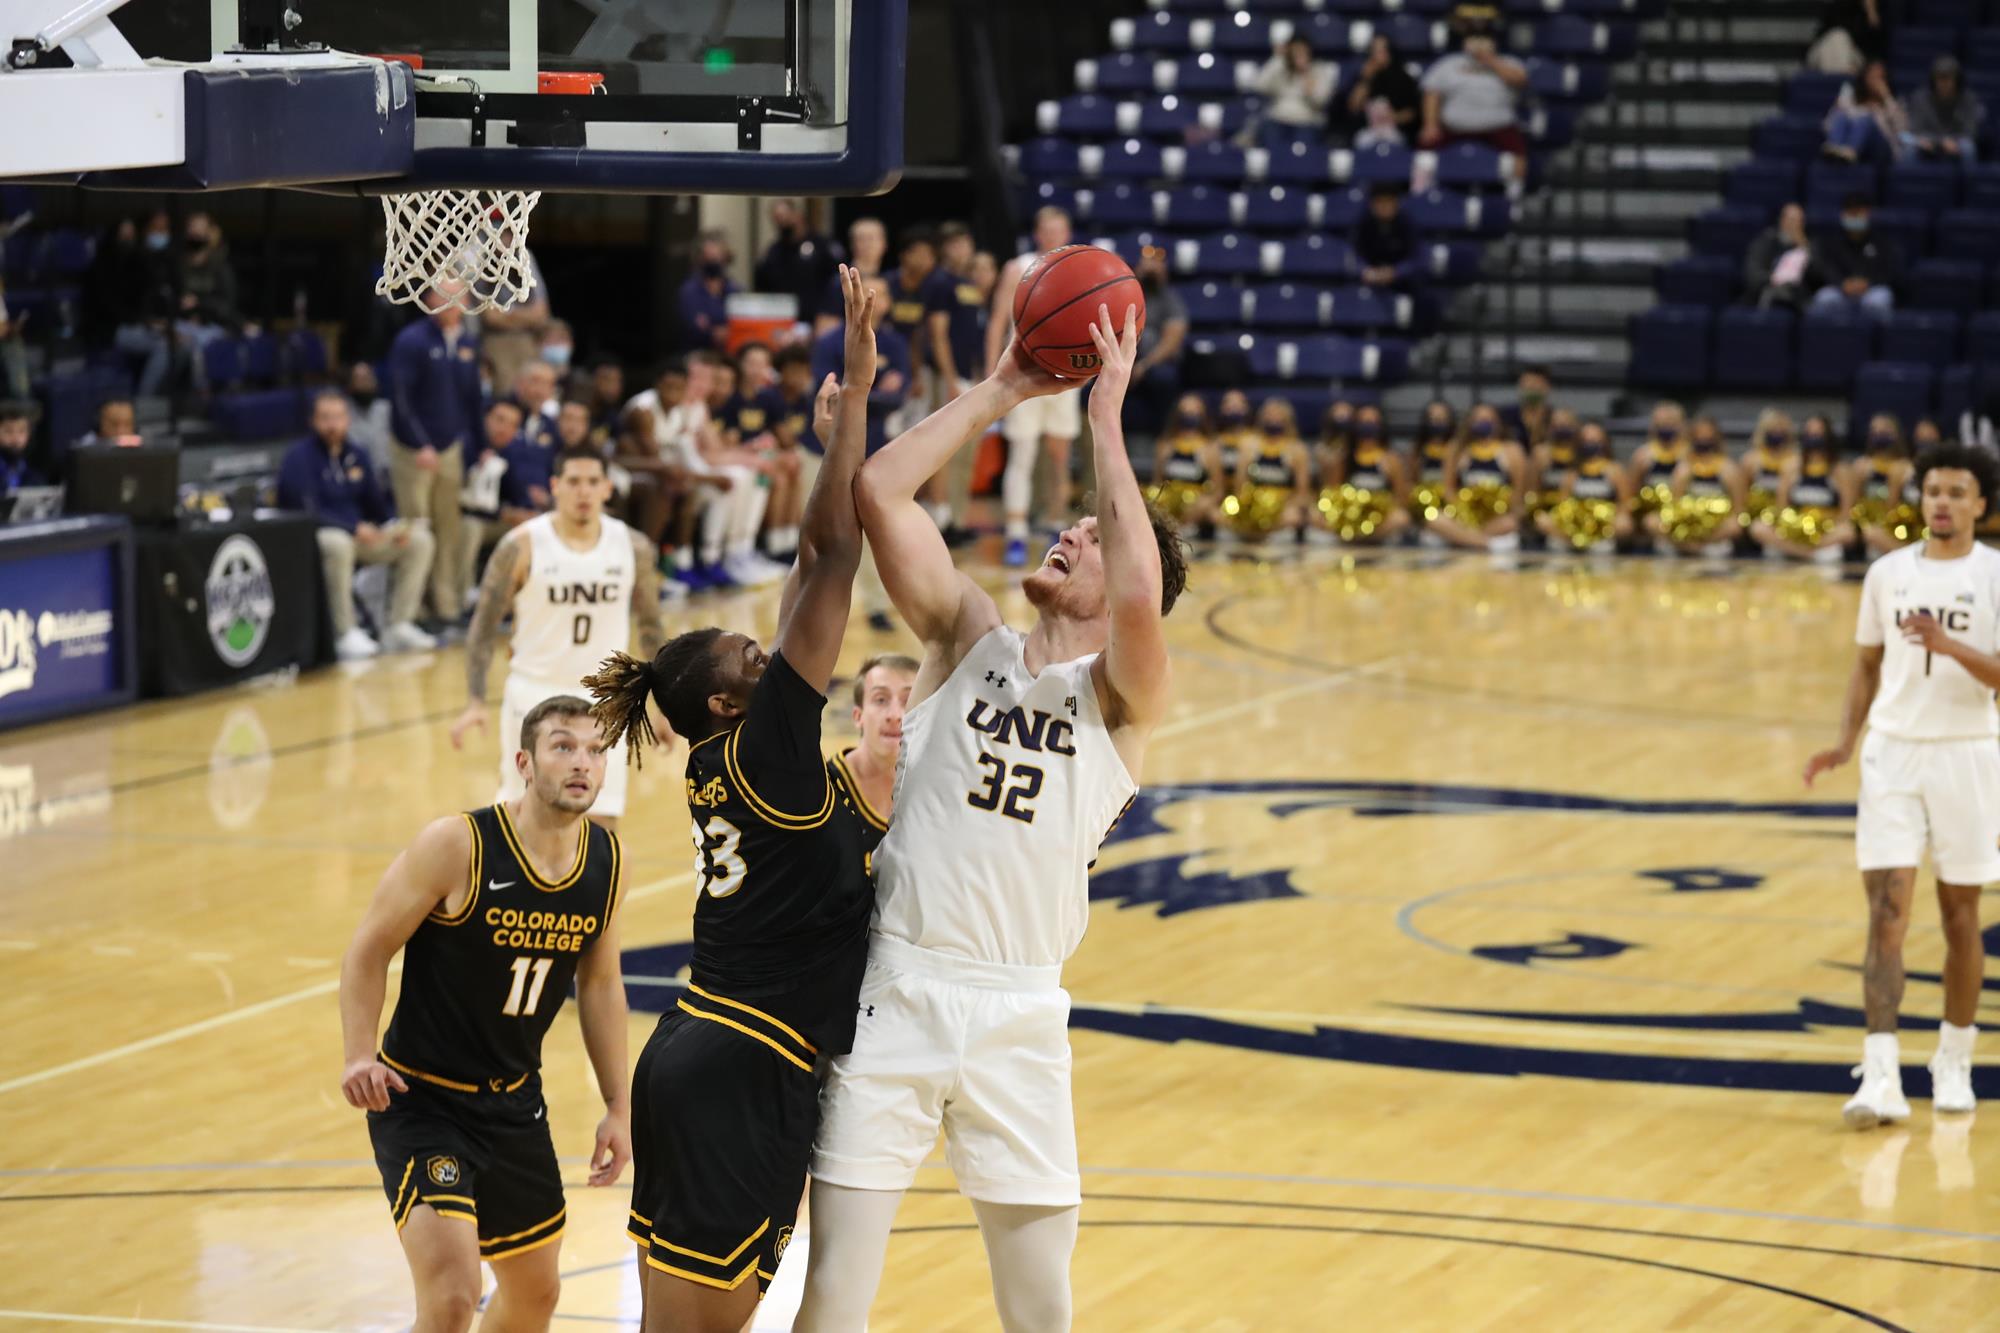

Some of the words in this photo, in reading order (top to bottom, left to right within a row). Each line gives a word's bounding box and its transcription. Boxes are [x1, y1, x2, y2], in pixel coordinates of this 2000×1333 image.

[548, 582, 620, 605] UNC
[966, 697, 1077, 758] UNC
[967, 751, 1044, 824] 32
[485, 907, 598, 934] COLORADO
[493, 928, 584, 952] COLLEGE
[502, 956, 554, 1017] 11
